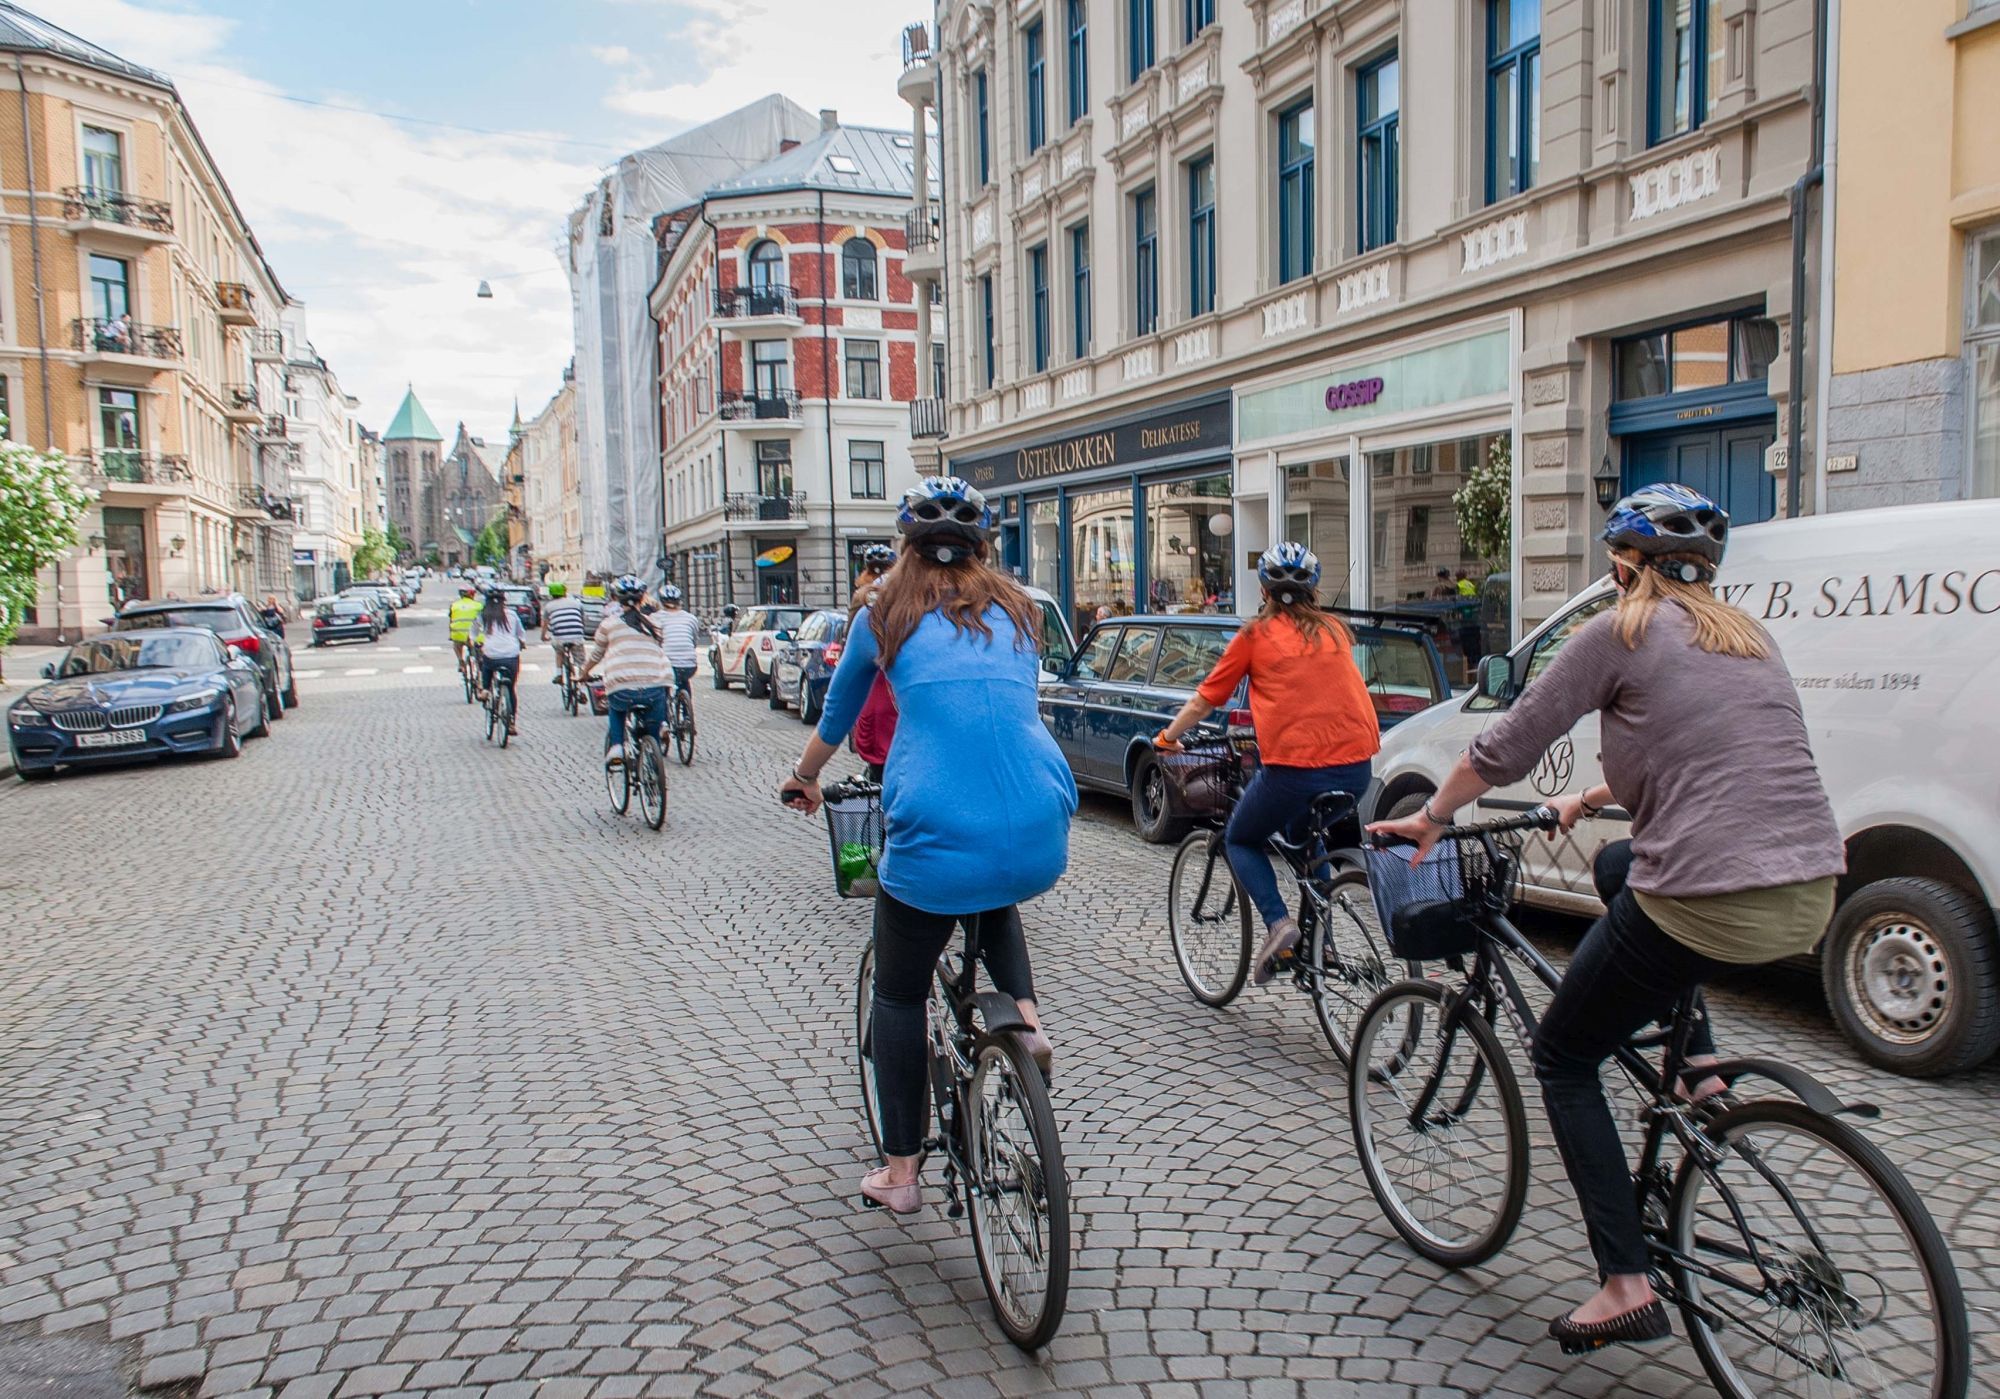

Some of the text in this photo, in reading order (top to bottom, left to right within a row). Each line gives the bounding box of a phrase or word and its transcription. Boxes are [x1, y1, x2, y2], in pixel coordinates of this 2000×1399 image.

[1326, 377, 1384, 411] GOSSIP
[1017, 432, 1115, 480] OSTEKLOKKEN
[1141, 421, 1200, 449] DELIKATESSE
[1775, 451, 1786, 467] 22
[1760, 580, 1798, 620] B.
[1834, 672, 1874, 690] siden
[1880, 672, 1920, 691] 1894
